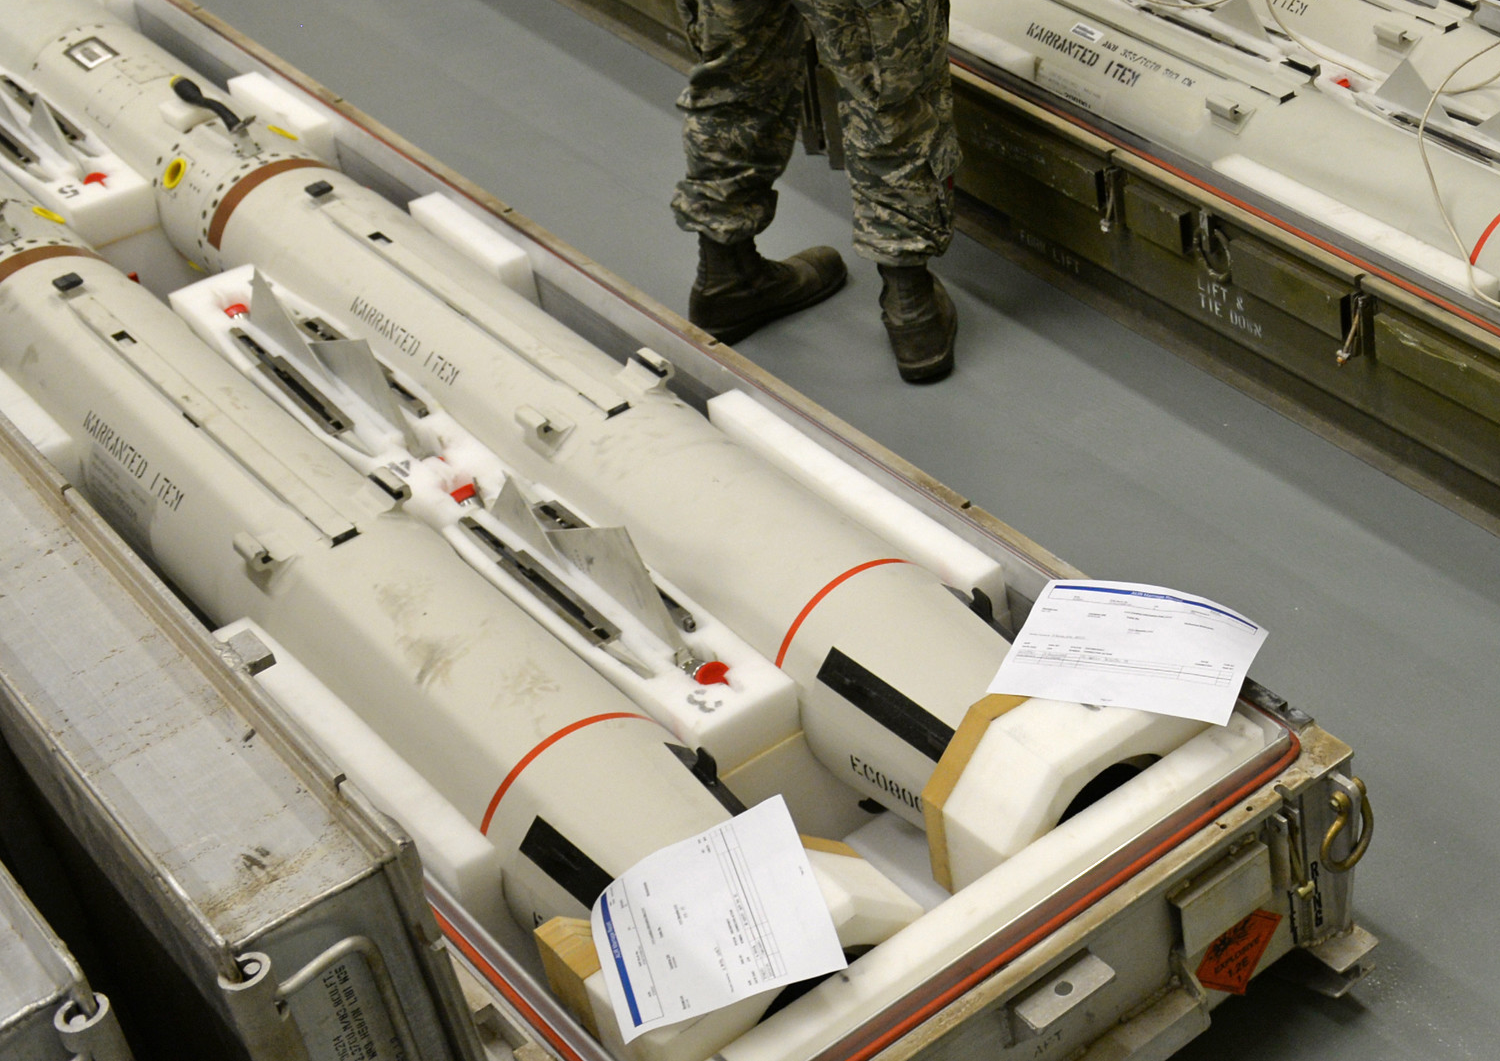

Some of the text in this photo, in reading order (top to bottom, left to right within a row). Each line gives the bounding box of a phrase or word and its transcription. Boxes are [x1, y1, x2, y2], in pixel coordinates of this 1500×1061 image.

[1026, 22, 1100, 67] WARRANTED
[1104, 60, 1141, 87] ITEM
[1197, 278, 1244, 311] LIFT &
[1199, 292, 1262, 338] TIE DOWN
[349, 296, 461, 386] WARRANTED ITEM
[82, 409, 148, 479] WARRANTED
[150, 472, 185, 512] ITEM
[1311, 860, 1324, 928] RING
[1213, 934, 1261, 974] EXPLOSIVE
